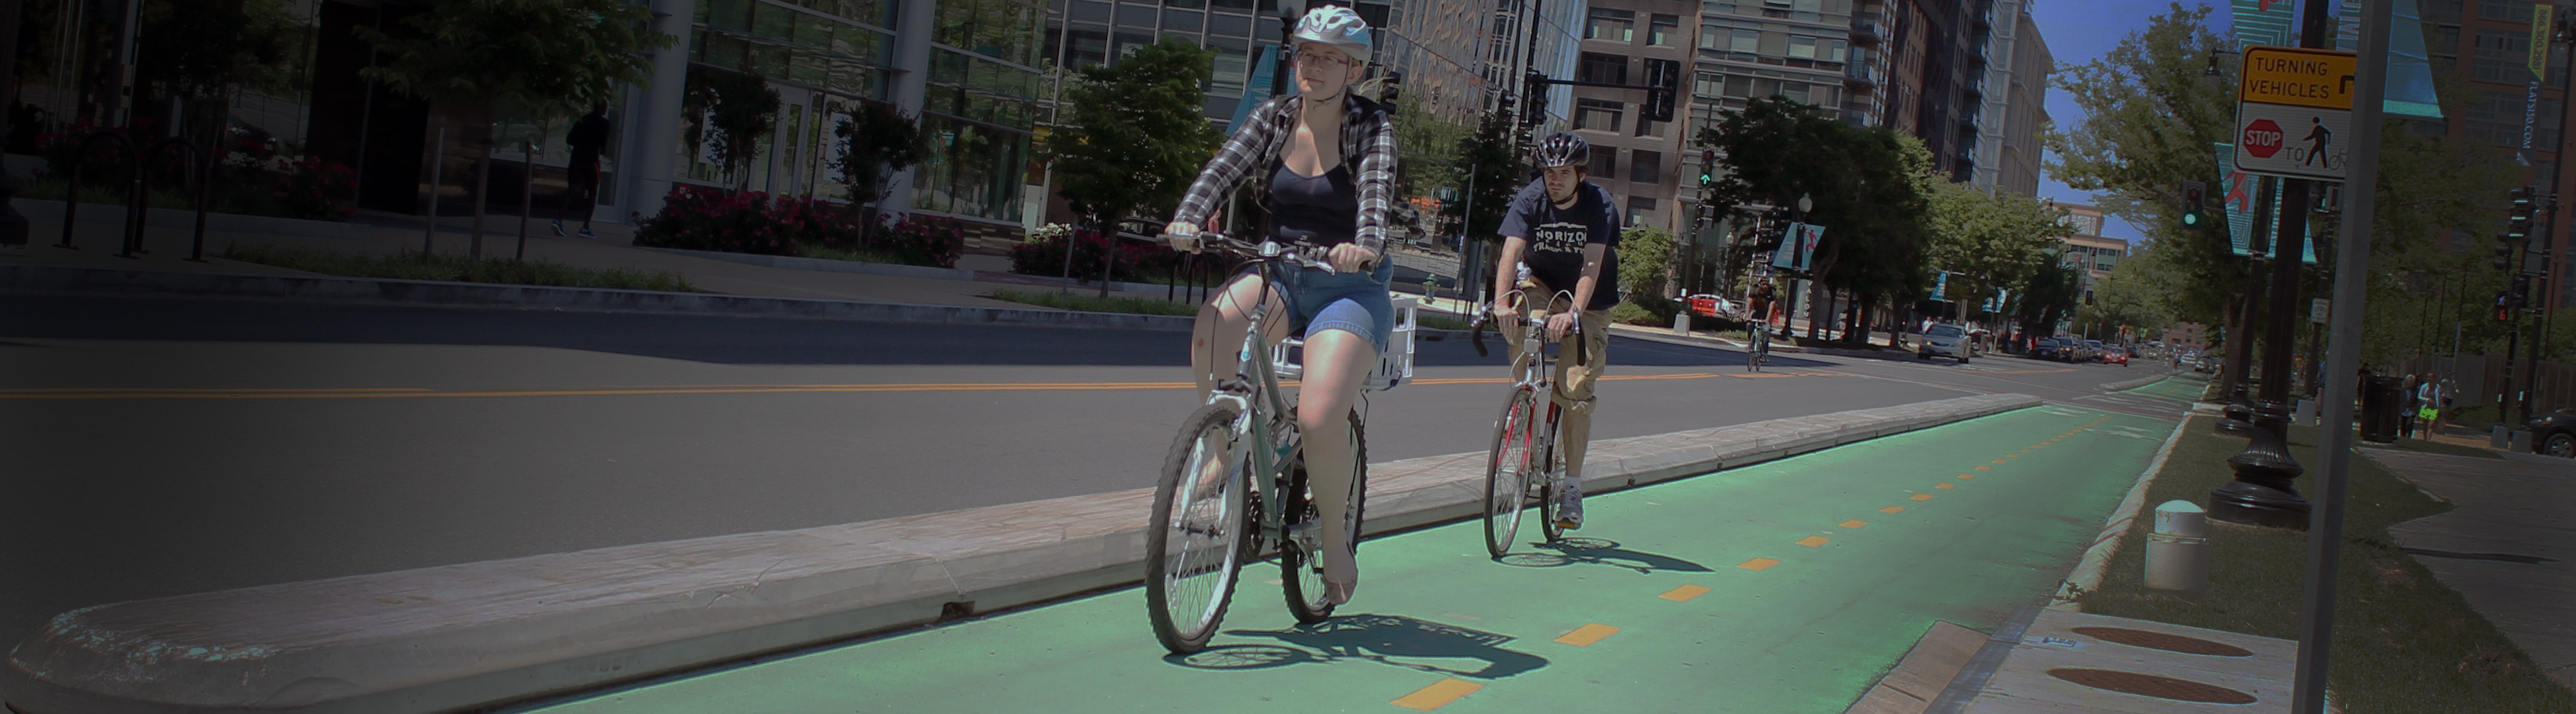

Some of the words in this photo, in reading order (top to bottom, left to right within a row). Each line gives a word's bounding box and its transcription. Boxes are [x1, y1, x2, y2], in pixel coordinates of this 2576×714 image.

[2255, 57, 2328, 76] TURNING
[2250, 79, 2330, 99] VEHICLES
[2246, 130, 2281, 147] STOP
[2285, 147, 2304, 162] TO
